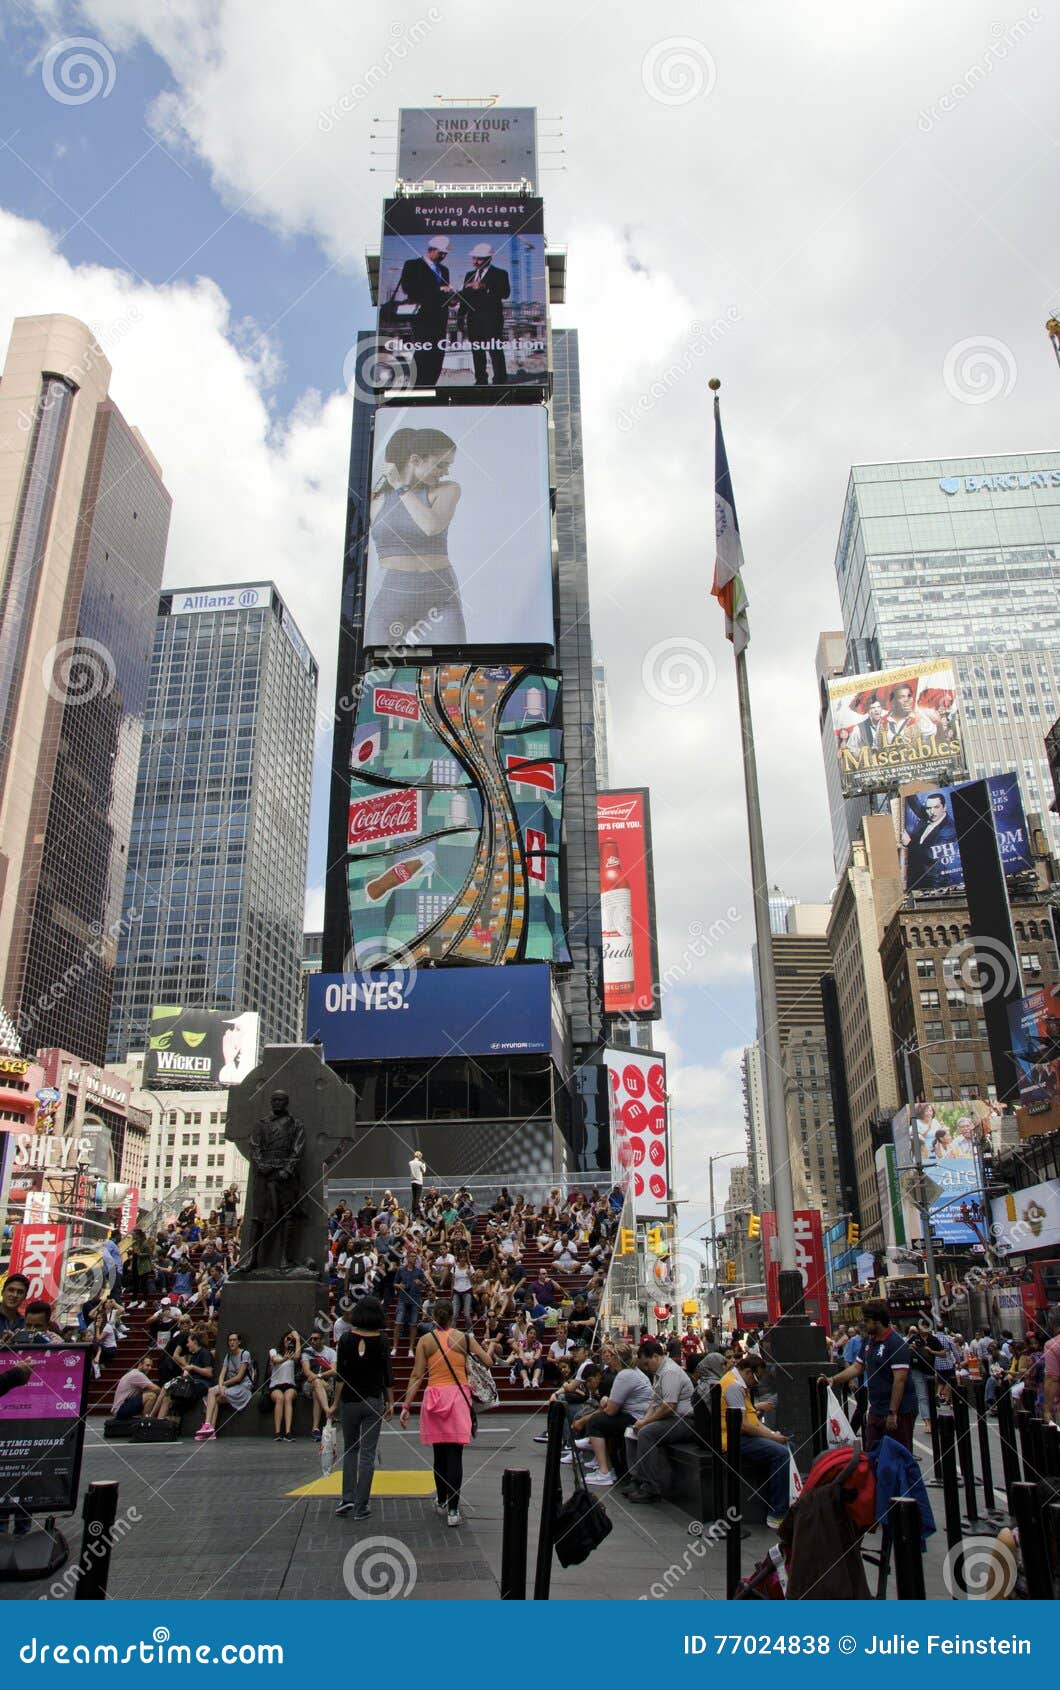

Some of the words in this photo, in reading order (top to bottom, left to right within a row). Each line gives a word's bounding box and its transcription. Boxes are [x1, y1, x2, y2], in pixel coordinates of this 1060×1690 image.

[436, 119, 469, 131] FIND
[474, 119, 511, 130] YOUR
[435, 132, 490, 143] CAREER
[415, 206, 463, 217] Reviving
[468, 204, 525, 214] Ancient
[425, 218, 457, 228] Trade
[462, 218, 510, 228] Routes
[384, 339, 433, 351] Close
[437, 338, 545, 351] Consultation
[964, 469, 1060, 494] BARCLAYS
[182, 595, 235, 610] Allianz
[376, 693, 417, 714] Coca-Cola
[881, 731, 912, 748] Les
[841, 734, 961, 771] Misérables
[992, 789, 1007, 797] UR
[351, 800, 414, 836] Coca-Cola
[612, 822, 625, 830] FOR
[941, 856, 955, 865] OF
[325, 983, 357, 1012] OH
[363, 981, 409, 1011] YES.
[14, 1133, 92, 1169] SHEY'S
[938, 1169, 977, 1186] are
[22, 1231, 56, 1300] tkts
[6, 1439, 32, 1447] TIMES
[33, 1438, 65, 1447] SQUARE
[8, 1448, 30, 1456] LOVE
